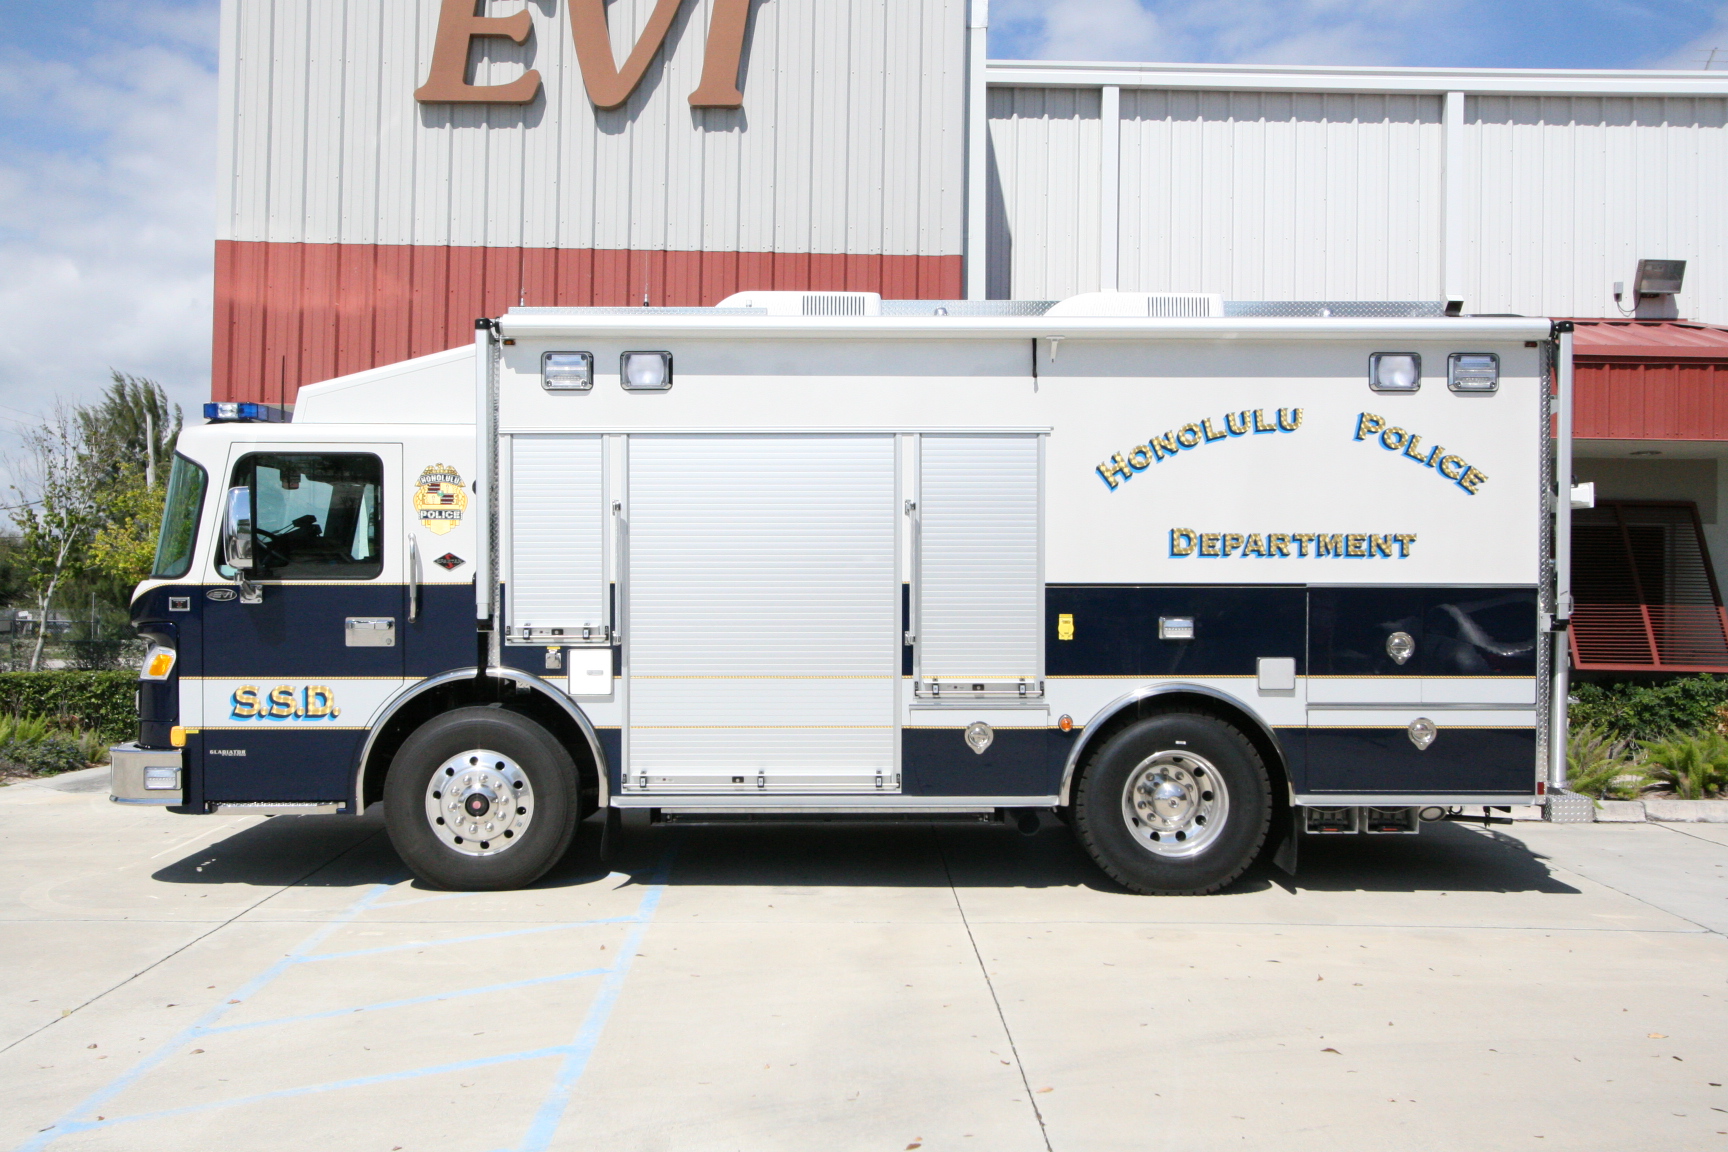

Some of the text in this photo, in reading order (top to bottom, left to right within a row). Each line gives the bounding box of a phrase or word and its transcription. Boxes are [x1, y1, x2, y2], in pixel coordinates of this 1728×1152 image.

[413, 0, 755, 110] EVI
[1095, 407, 1489, 495] HONOLULU POLICE
[420, 474, 460, 485] HONOLULU
[420, 510, 461, 519] POLICE
[1168, 527, 1417, 559] DEPARTMENT
[229, 684, 342, 721] S.S.D.
